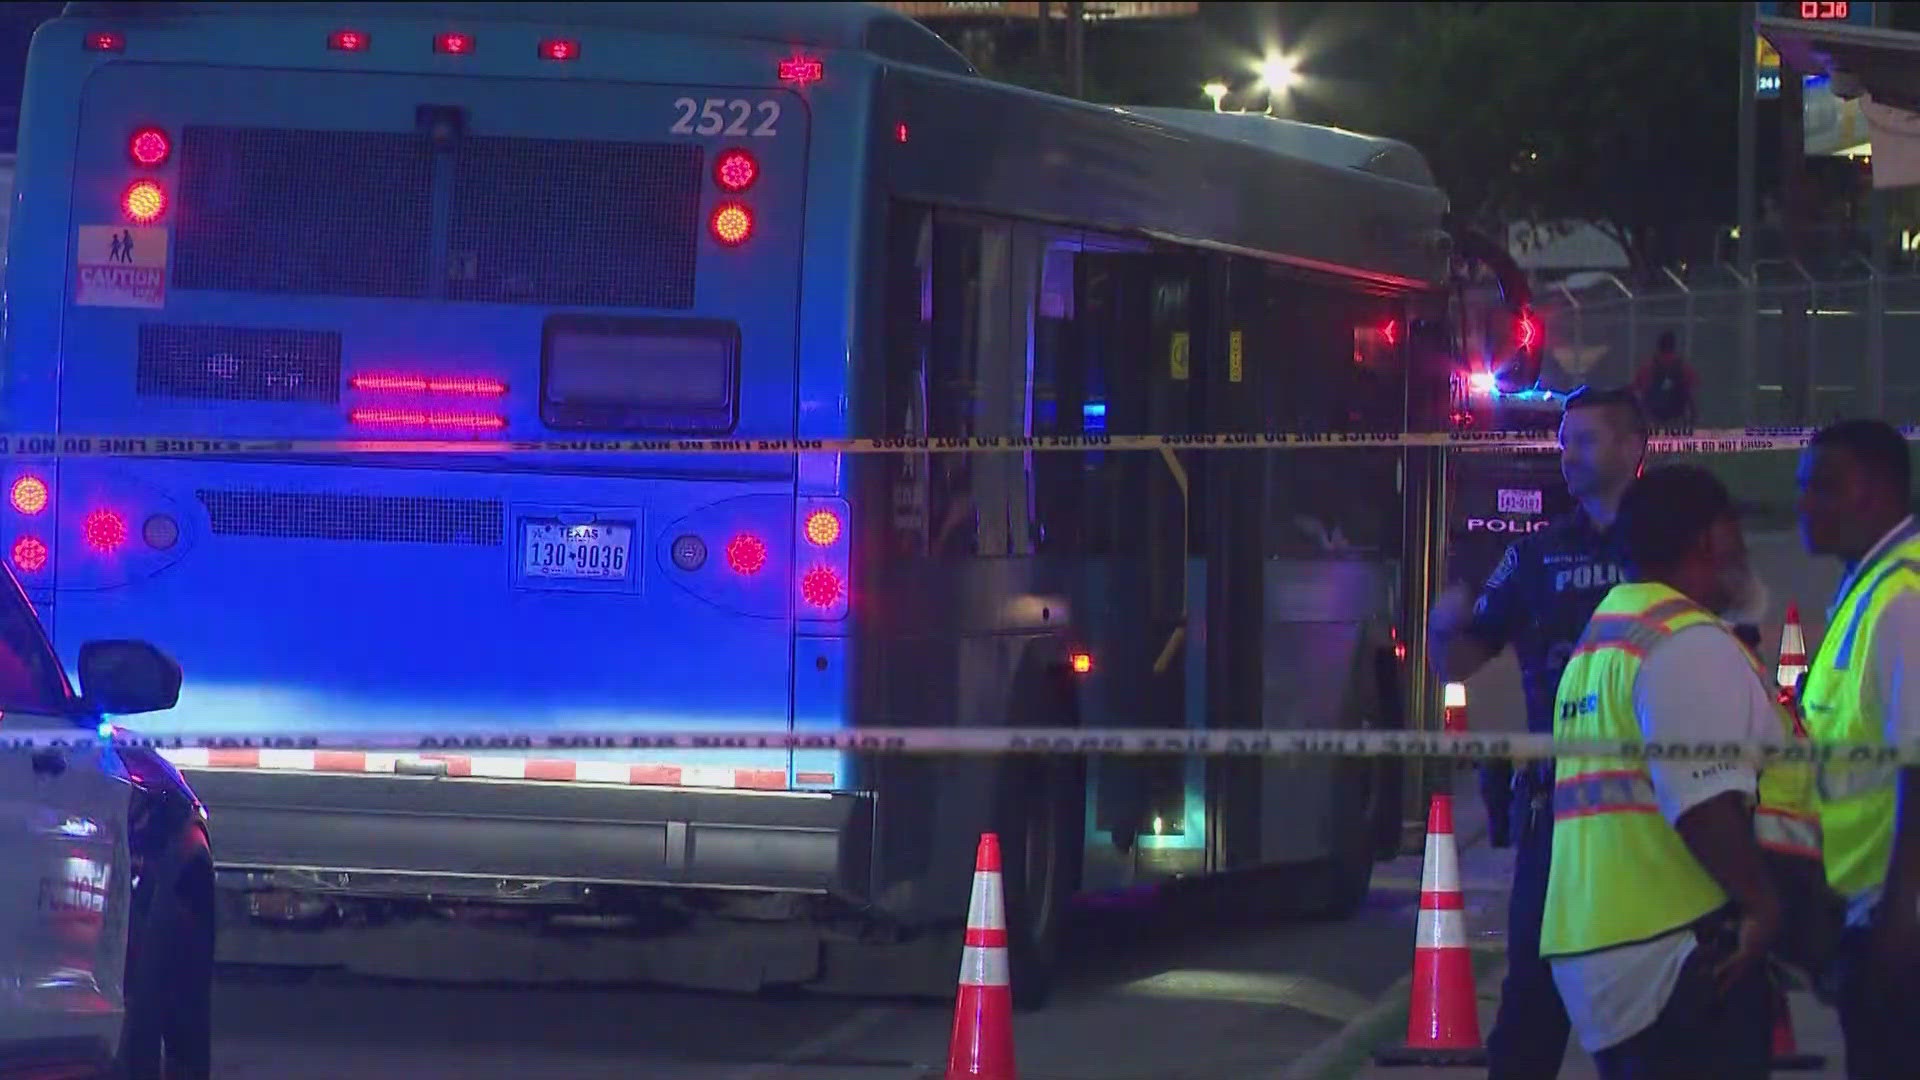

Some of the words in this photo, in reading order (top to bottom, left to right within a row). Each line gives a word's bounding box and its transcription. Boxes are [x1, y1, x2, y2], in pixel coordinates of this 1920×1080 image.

[671, 97, 781, 137] 2522
[80, 267, 161, 287] CAUTION
[16, 437, 55, 455] NOT
[559, 527, 599, 539] TEXAS
